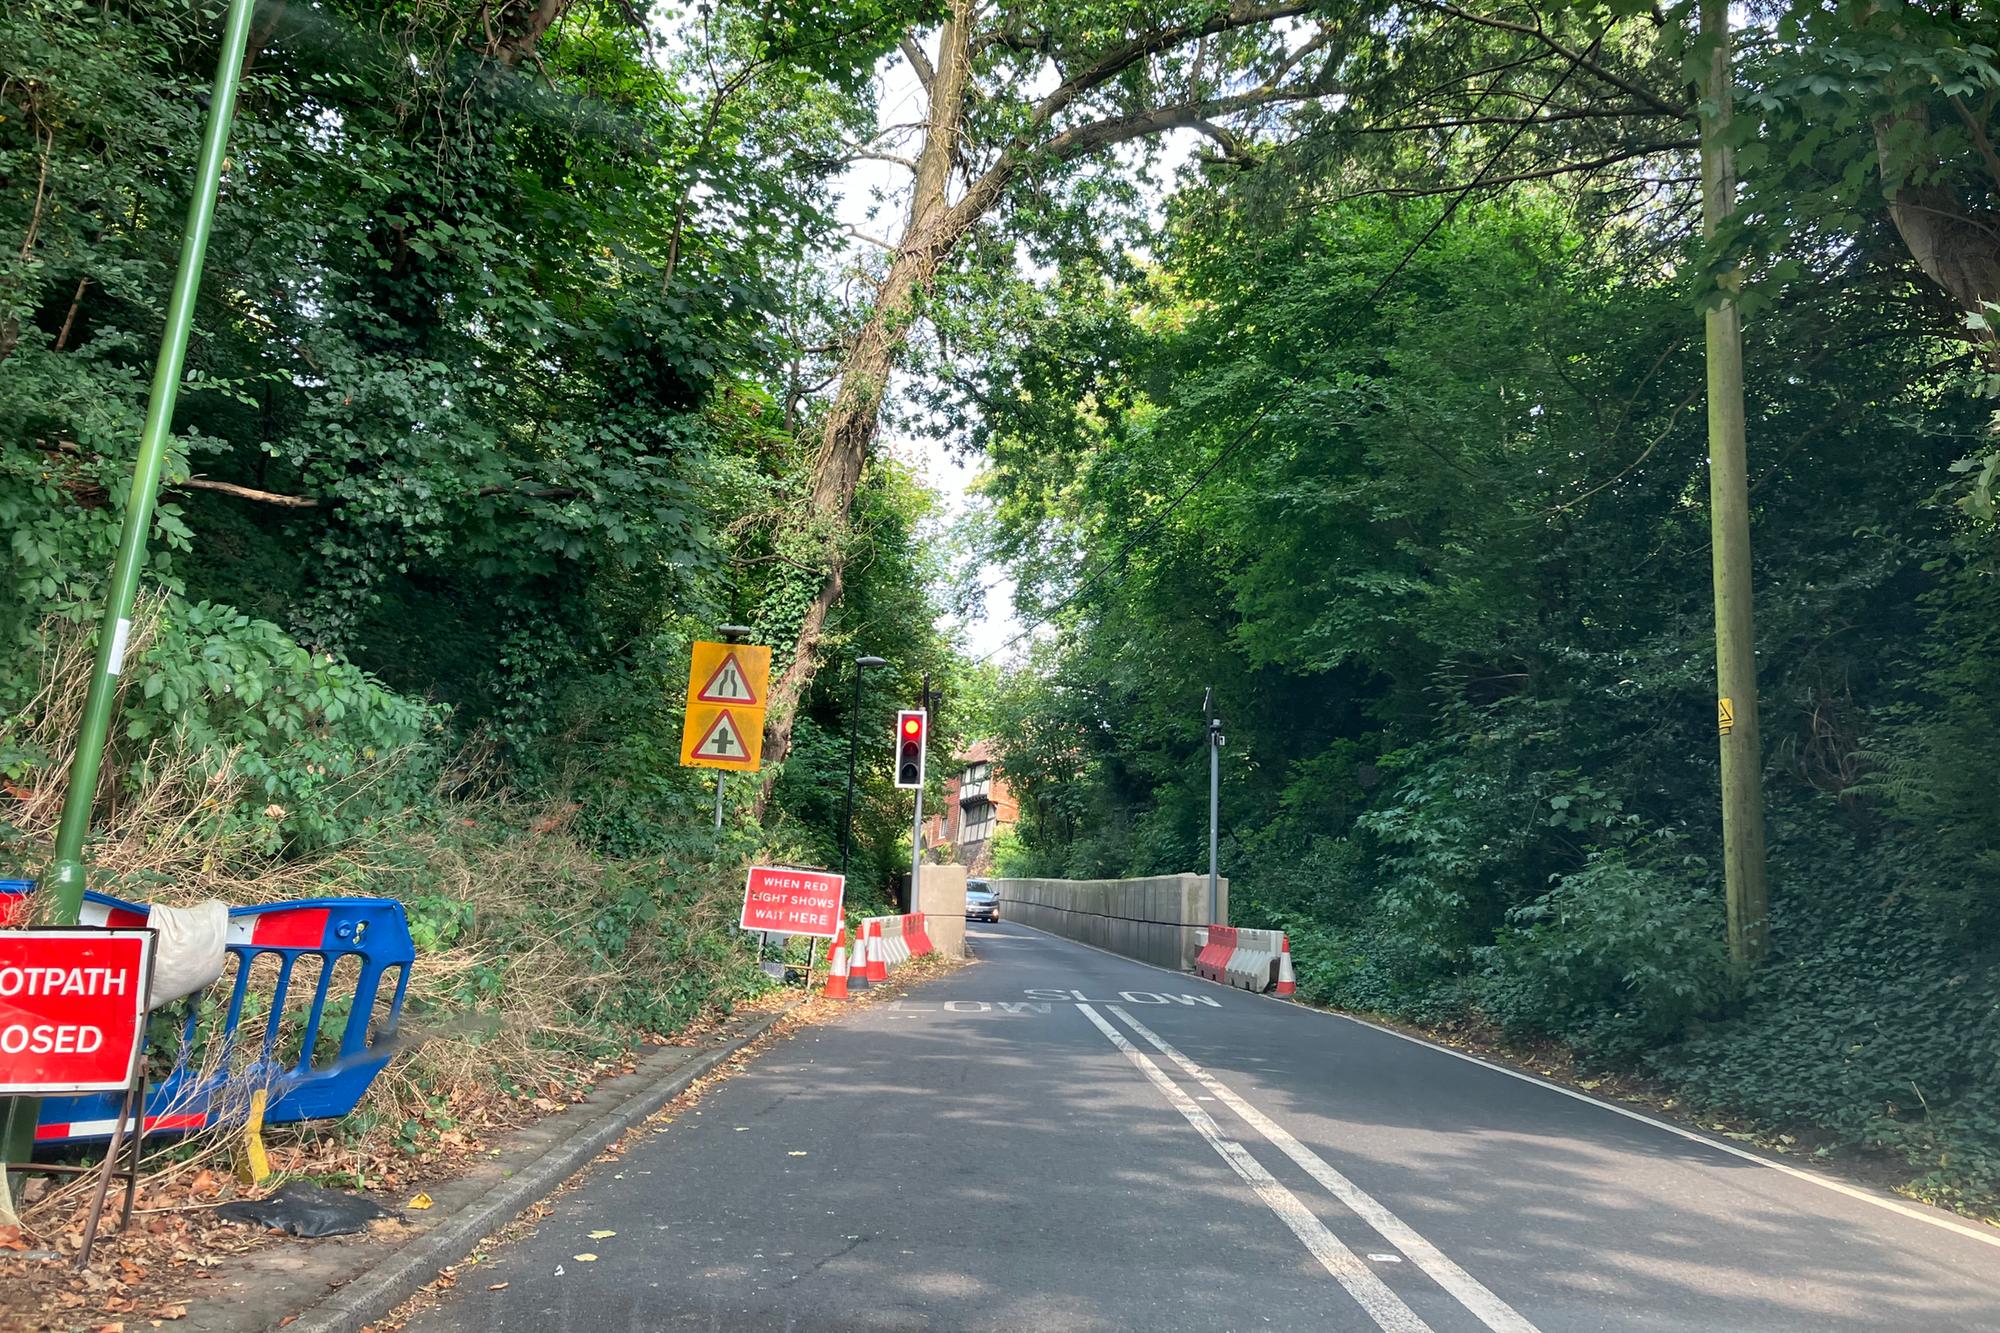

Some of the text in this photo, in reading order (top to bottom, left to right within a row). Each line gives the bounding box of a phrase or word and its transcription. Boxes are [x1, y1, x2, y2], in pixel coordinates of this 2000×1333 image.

[764, 877, 828, 892] WHEN RED
[791, 896, 834, 908] SHOWS
[755, 909, 828, 925] WAIT HERE
[0, 967, 127, 997] OTPATH
[1023, 988, 1223, 1008] SLOW
[1, 1024, 103, 1054] OSED
